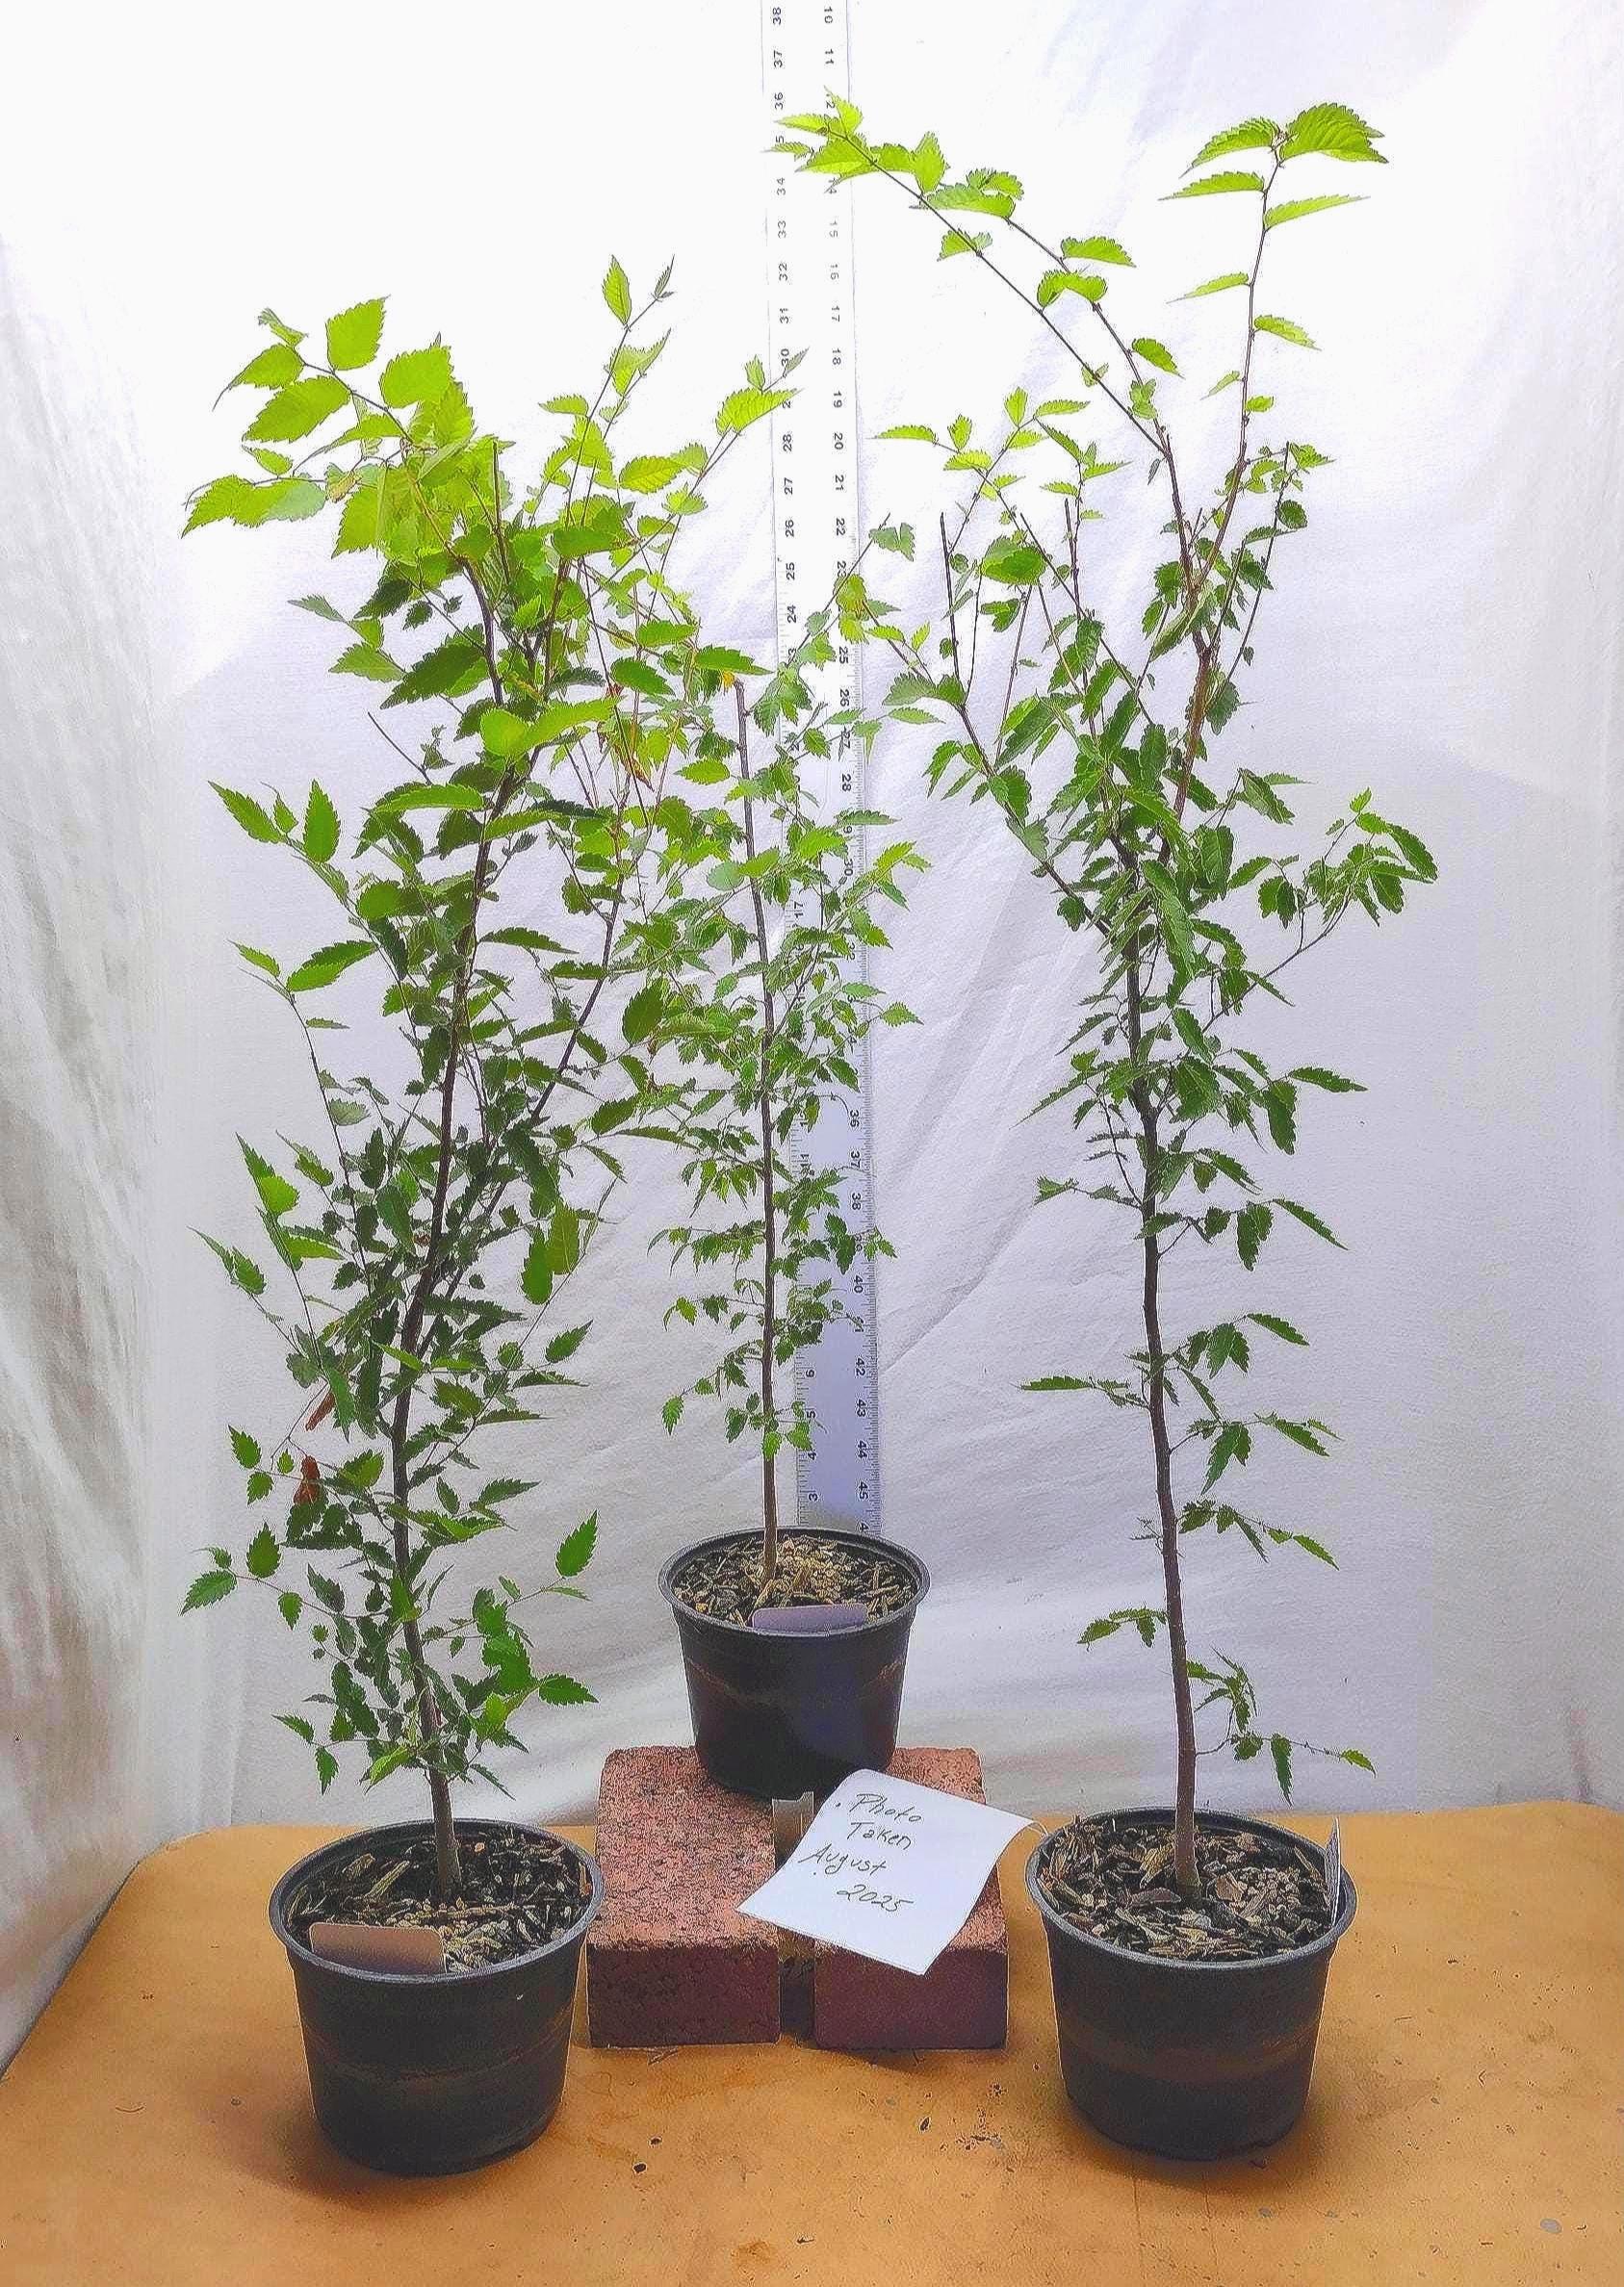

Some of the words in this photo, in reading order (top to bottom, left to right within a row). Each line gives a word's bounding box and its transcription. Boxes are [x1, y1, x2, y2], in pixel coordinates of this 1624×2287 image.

[772, 7, 782, 25] 38
[824, 6, 834, 24] 10
[773, 50, 783, 68] 37
[825, 49, 835, 64] 11
[774, 92, 784, 110] 36
[777, 177, 786, 195] 34
[778, 220, 786, 239] 33
[829, 220, 838, 238] 15
[779, 263, 787, 281] 32
[831, 264, 839, 280] 16
[780, 308, 788, 323] 31
[832, 305, 840, 322] 17
[833, 348, 841, 366] 18
[834, 390, 842, 408] 19
[783, 434, 792, 452] 28
[835, 432, 843, 450] 20
[784, 477, 793, 495] 27
[836, 475, 844, 491] 21
[786, 519, 794, 537] 26
[837, 518, 845, 536] 22
[786, 562, 795, 580] 25
[787, 604, 796, 624] 24
[839, 646, 848, 664] 25
[840, 689, 849, 707] 26
[842, 774, 852, 791] 28
[844, 859, 854, 876] 30
[794, 901, 803, 918] 17
[850, 1110, 860, 1127] 36
[851, 1150, 861, 1169] 37
[852, 1193, 862, 1211] 38
[854, 1275, 864, 1293] 40
[806, 1370, 815, 1378] 6
[856, 1358, 865, 1376] 42
[857, 1399, 866, 1417] 43
[858, 1440, 867, 1458] 44
[809, 1493, 818, 1502] 3
[859, 1481, 868, 1500] 45
[849, 1793, 922, 1823] Photo
[847, 1822, 912, 1850] Taken
[798, 1843, 887, 1875] August
[837, 1884, 914, 1912] 2025
